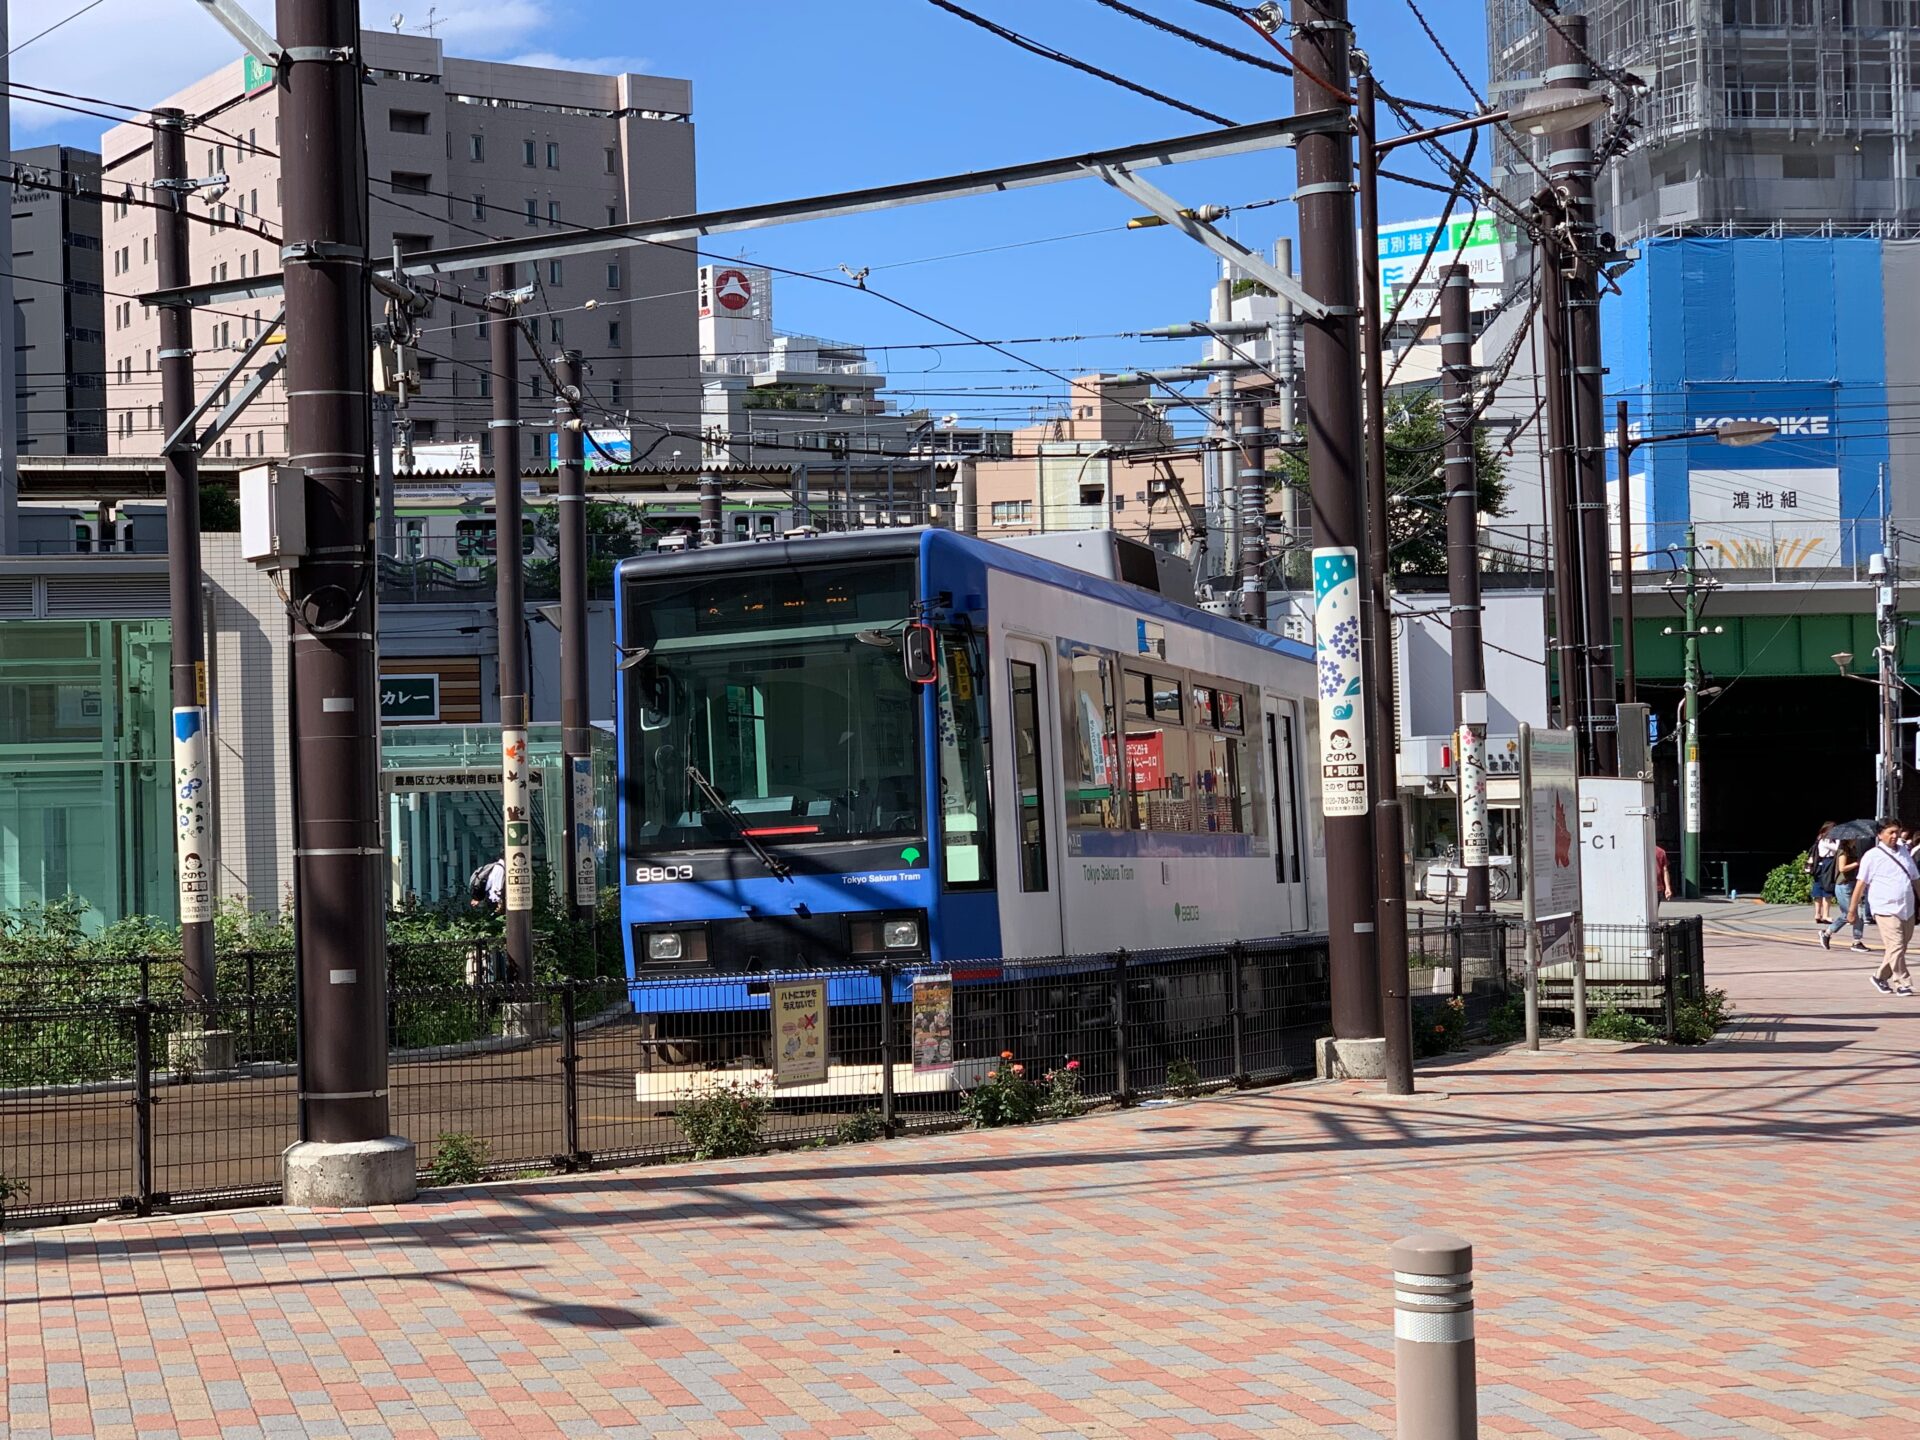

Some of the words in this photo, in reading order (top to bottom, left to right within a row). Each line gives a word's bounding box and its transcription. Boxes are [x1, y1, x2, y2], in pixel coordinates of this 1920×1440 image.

[1733, 491, 1797, 509] 鴻池組
[381, 691, 431, 706] カレー
[636, 865, 693, 882] 8903
[842, 876, 868, 886] Tokyo
[868, 874, 898, 883] Sakura
[898, 873, 921, 881] Tram
[1083, 864, 1100, 885] Tokyo
[1101, 864, 1119, 881] Sakura
[1120, 864, 1134, 881] Tram
[1182, 905, 1199, 922] 8903
[781, 990, 817, 1000] ハトにエサを
